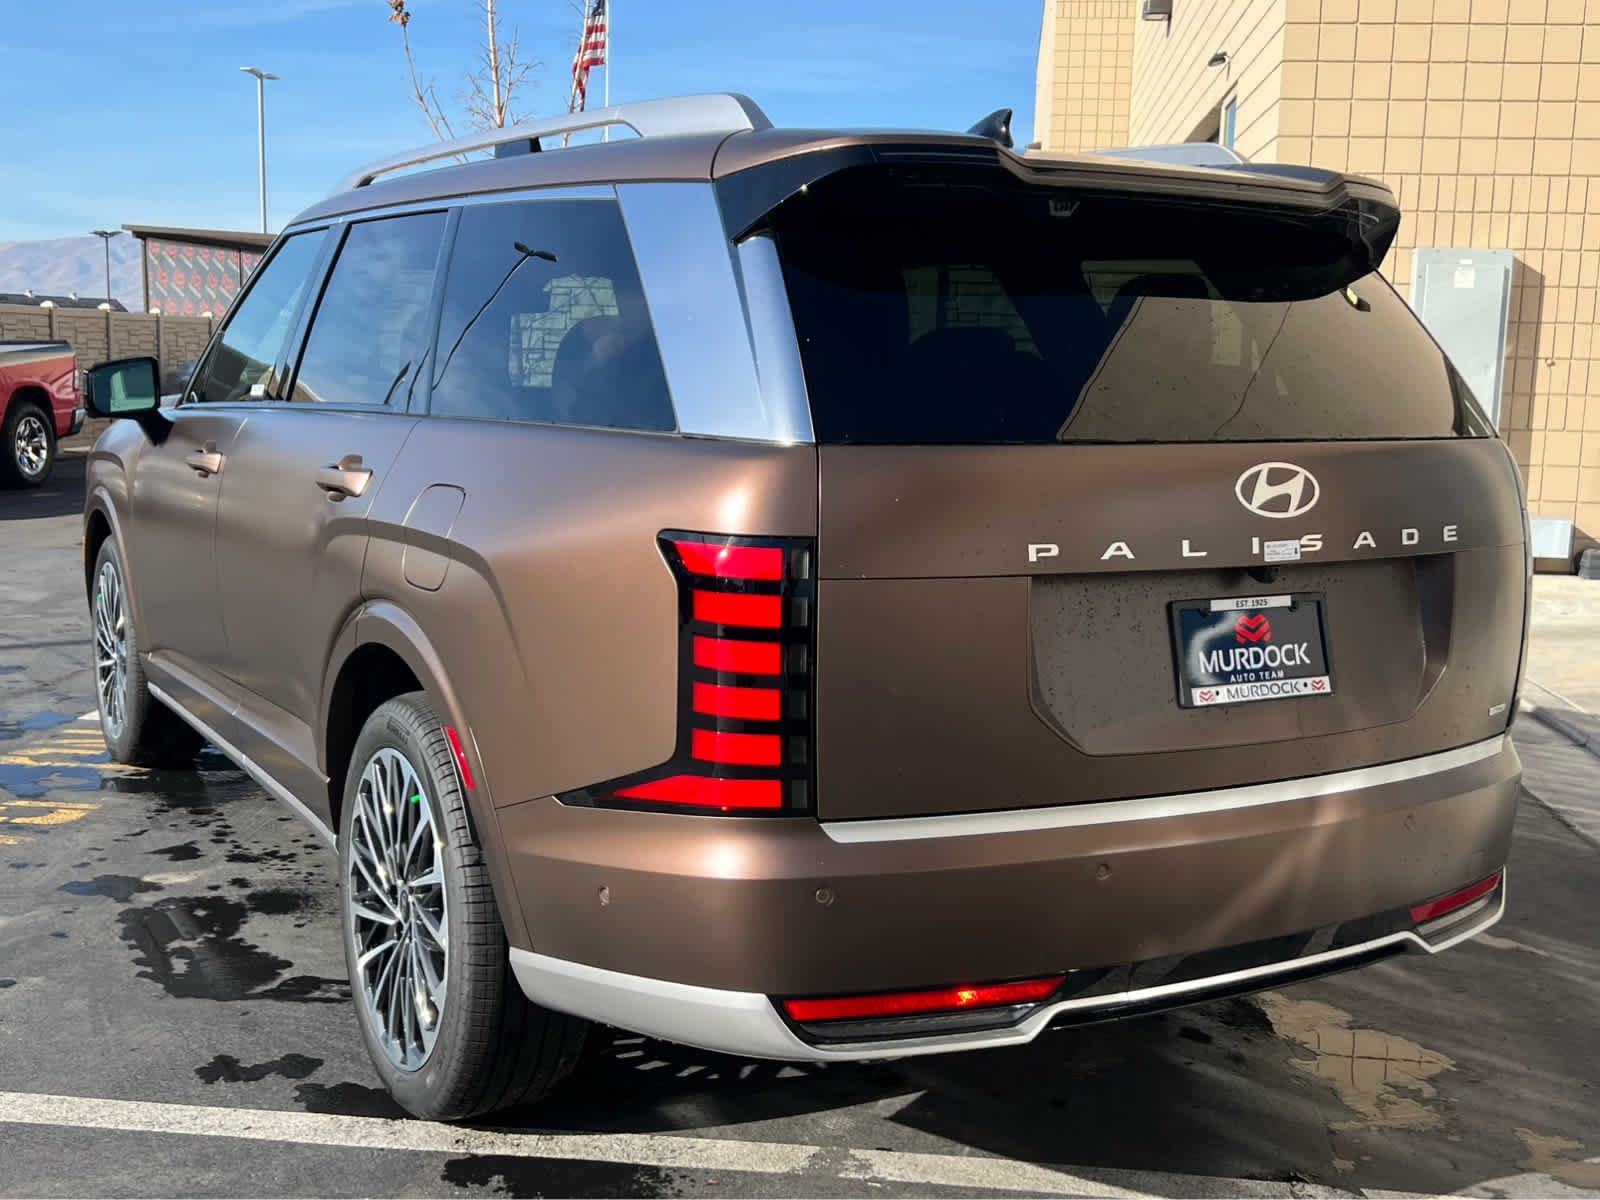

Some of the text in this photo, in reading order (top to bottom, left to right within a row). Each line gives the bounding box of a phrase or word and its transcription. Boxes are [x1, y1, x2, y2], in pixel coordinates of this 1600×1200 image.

[1028, 525, 1458, 562] PALISADE
[1235, 599, 1268, 608] EST 1925
[1199, 642, 1311, 673] MURDOCK
[1230, 670, 1284, 683] AUTO TEAM
[1226, 682, 1301, 700] MURDOCK
